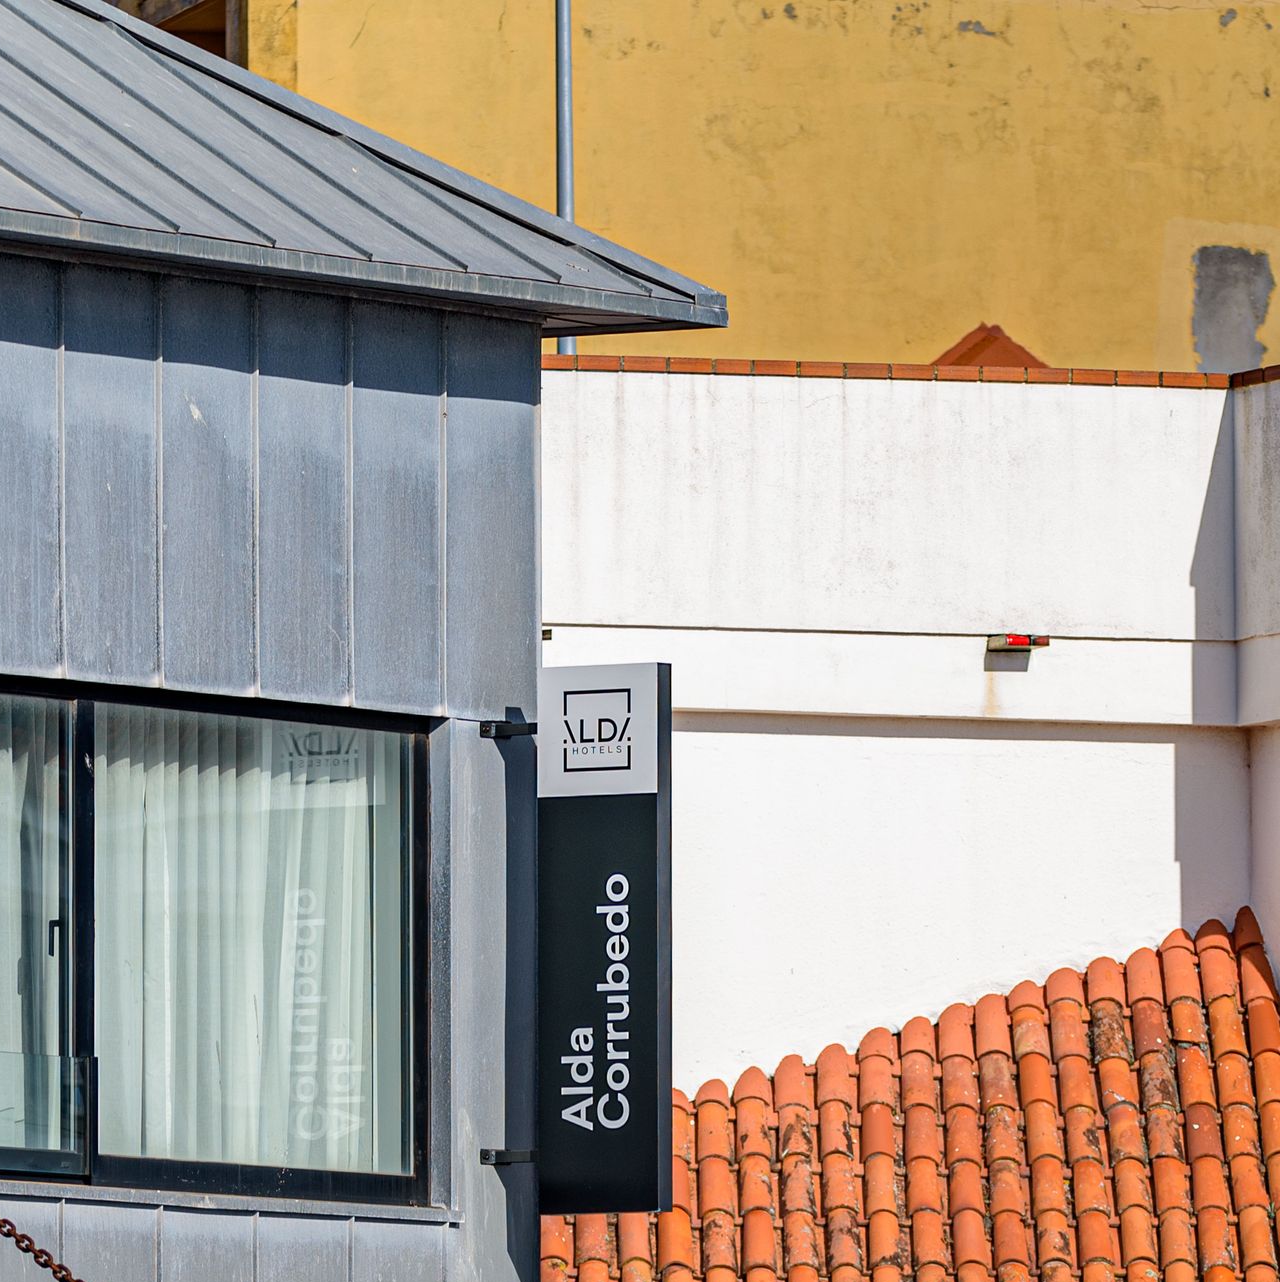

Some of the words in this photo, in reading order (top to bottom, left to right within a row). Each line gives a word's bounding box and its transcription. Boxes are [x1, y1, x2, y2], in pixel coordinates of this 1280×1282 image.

[572, 745, 623, 755] HOTELS
[596, 873, 630, 1129] Corrubedo
[561, 1027, 594, 1131] Alda
